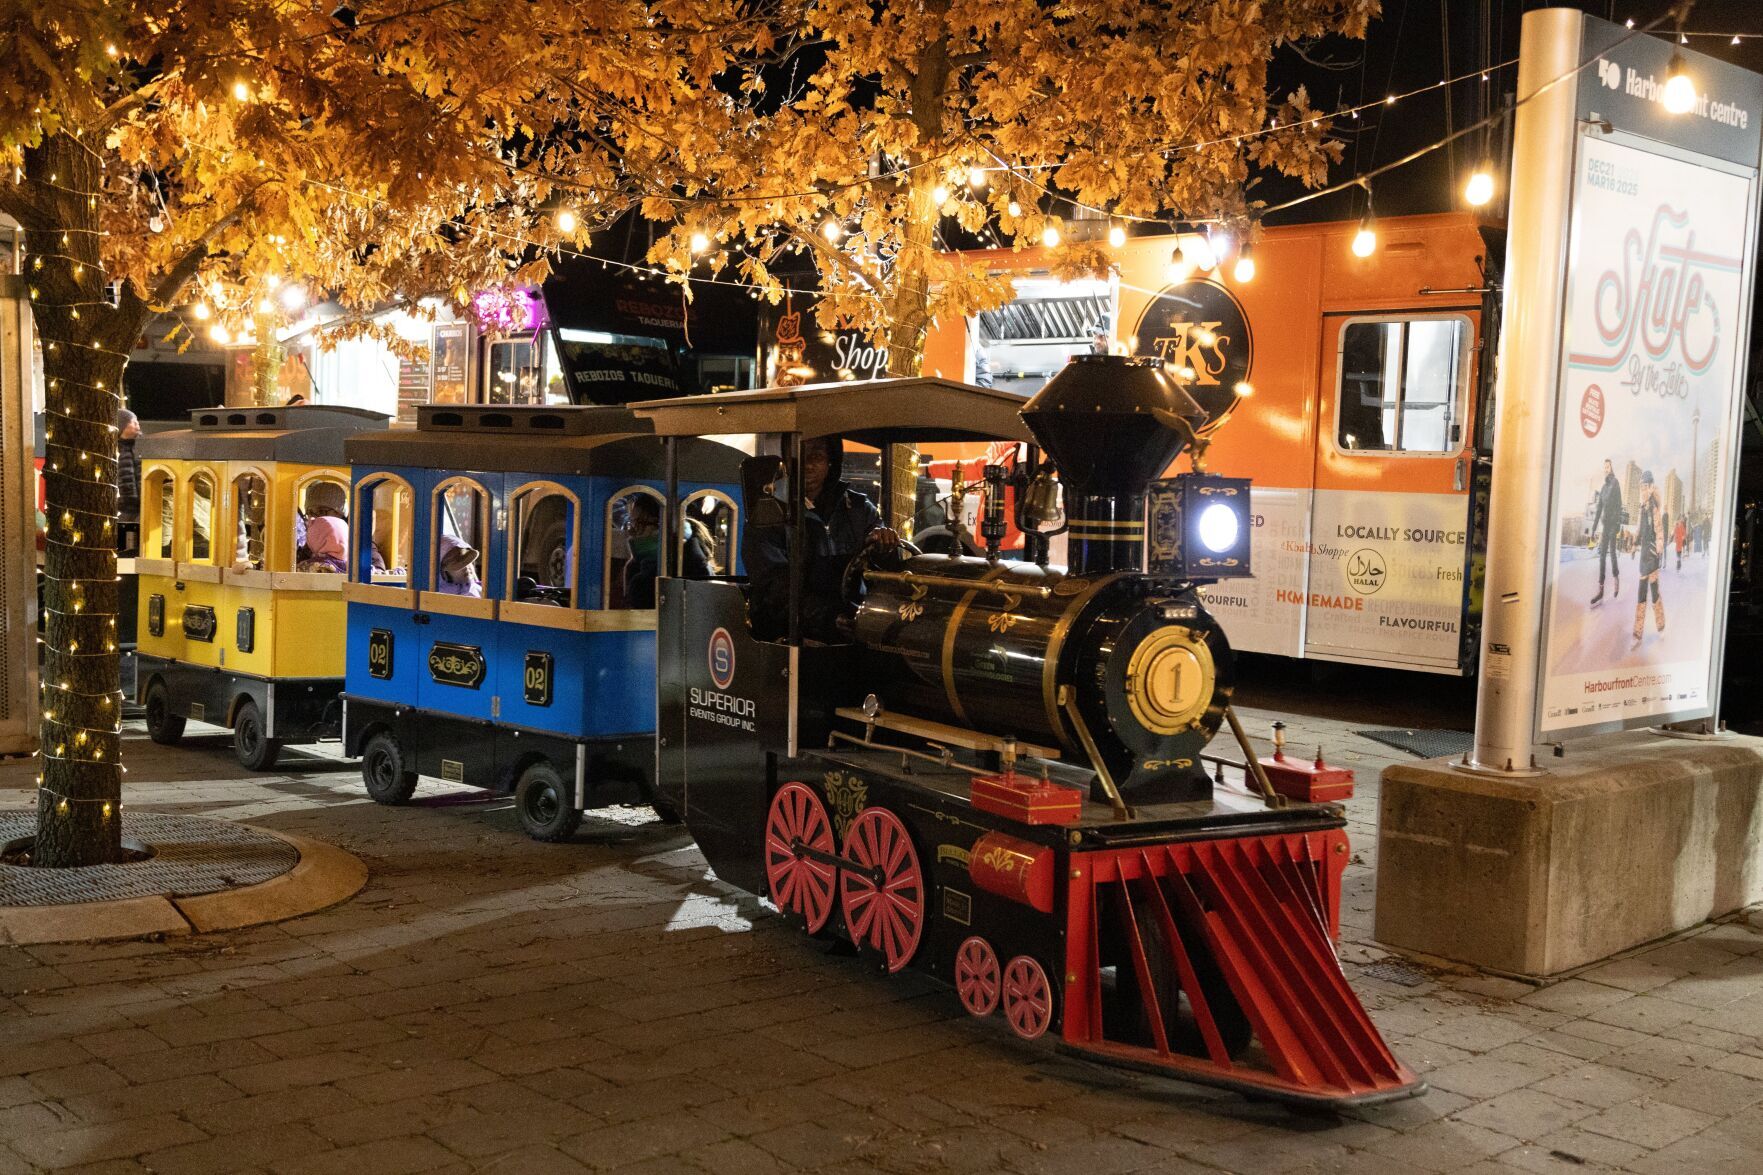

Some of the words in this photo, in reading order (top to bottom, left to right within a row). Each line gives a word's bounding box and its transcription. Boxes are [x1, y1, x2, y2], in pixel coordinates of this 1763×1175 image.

[1626, 68, 1708, 118] Harbont
[1710, 100, 1748, 130] centre
[1617, 179, 1639, 196] 2025
[1592, 204, 1726, 377] Skate
[575, 370, 625, 383] REBOZOS
[630, 371, 679, 390] TAQUERI
[1337, 525, 1400, 541] LOCALLY
[1403, 528, 1466, 545] SOURCE
[1353, 578, 1379, 587] HALAL
[1436, 567, 1462, 582] Fresh
[1379, 615, 1457, 633] FLAVOURFUL
[370, 643, 386, 665] 02
[715, 647, 728, 672] S
[526, 667, 544, 691] 02
[1169, 662, 1184, 704] 1
[1584, 673, 1672, 694] HarbourfrontCentre.com
[690, 687, 756, 718] SUPERIOR
[690, 706, 716, 722] EVENTS
[716, 713, 740, 728] GROUP
